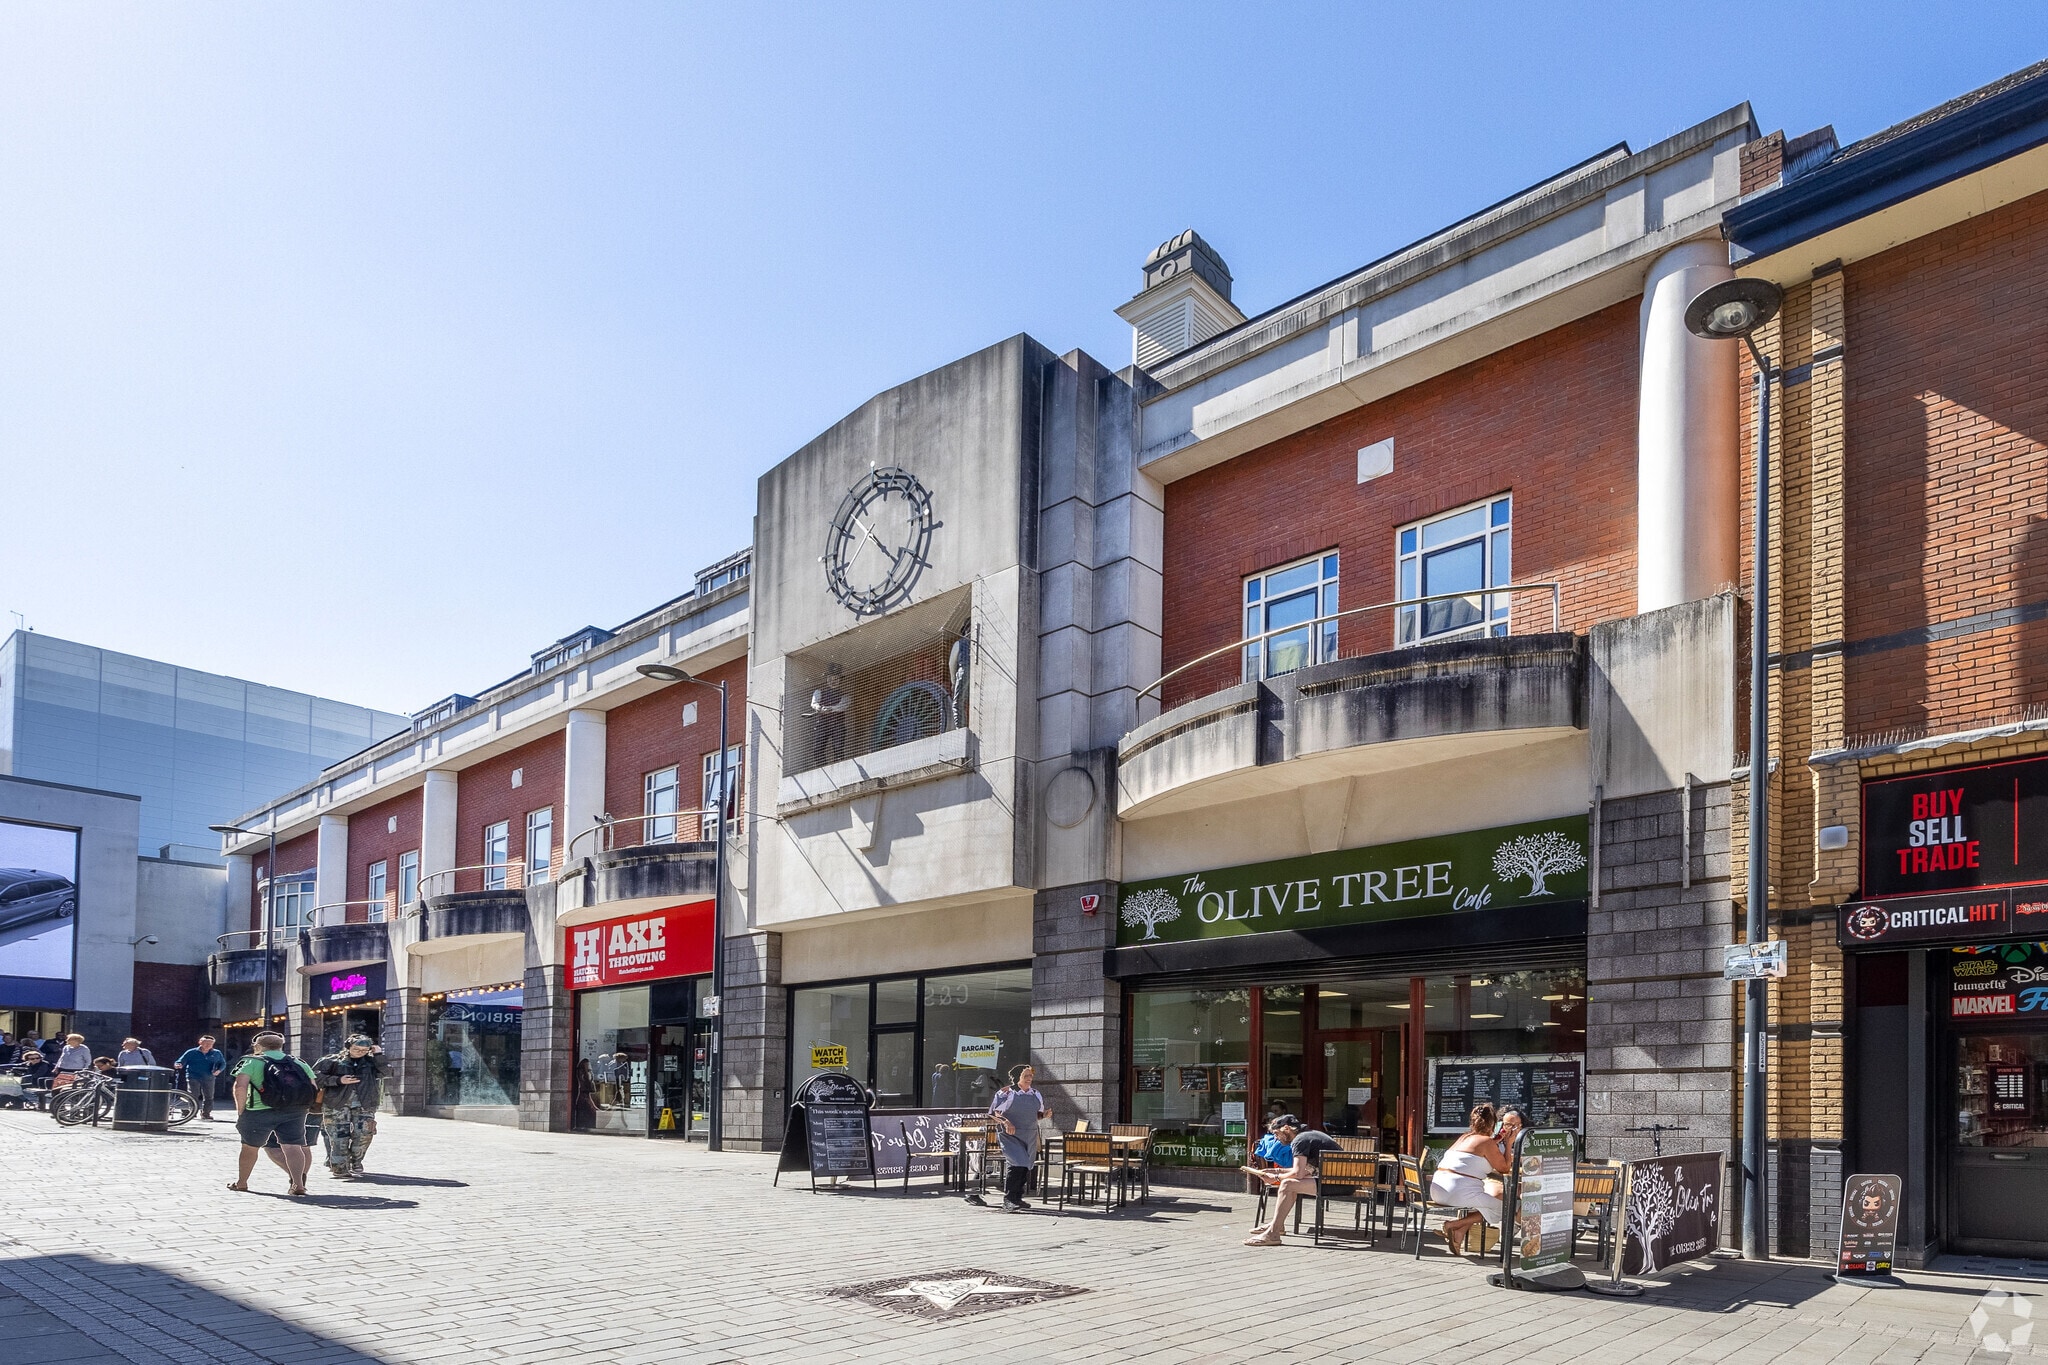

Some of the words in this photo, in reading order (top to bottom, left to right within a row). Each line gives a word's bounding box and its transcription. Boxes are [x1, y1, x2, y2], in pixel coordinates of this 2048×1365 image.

[1912, 788, 1964, 820] BUY
[1909, 815, 1967, 847] SELL
[1896, 840, 1980, 875] TRADE
[1183, 874, 1206, 897] The
[1197, 878, 1322, 923] OLIVE
[1332, 861, 1454, 908] TREE
[1453, 884, 1492, 912] Cafe
[608, 916, 666, 956] AXE
[573, 927, 600, 969] H
[608, 950, 666, 968] THROWING
[1958, 960, 1997, 969] STAR
[1953, 966, 1996, 977] WARS
[1953, 980, 2008, 991] loungefly
[1953, 996, 2014, 1015] MARVEL
[814, 1048, 844, 1057] WATCH
[961, 1044, 995, 1052] BARGAINS
[819, 1057, 844, 1065] SPACE
[630, 1096, 647, 1104] AXE
[1533, 1138, 1549, 1147] OLIVE
[1550, 1138, 1562, 1146] TREE
[1153, 1145, 1187, 1156] OLIVE
[1189, 1146, 1219, 1158] TREE
